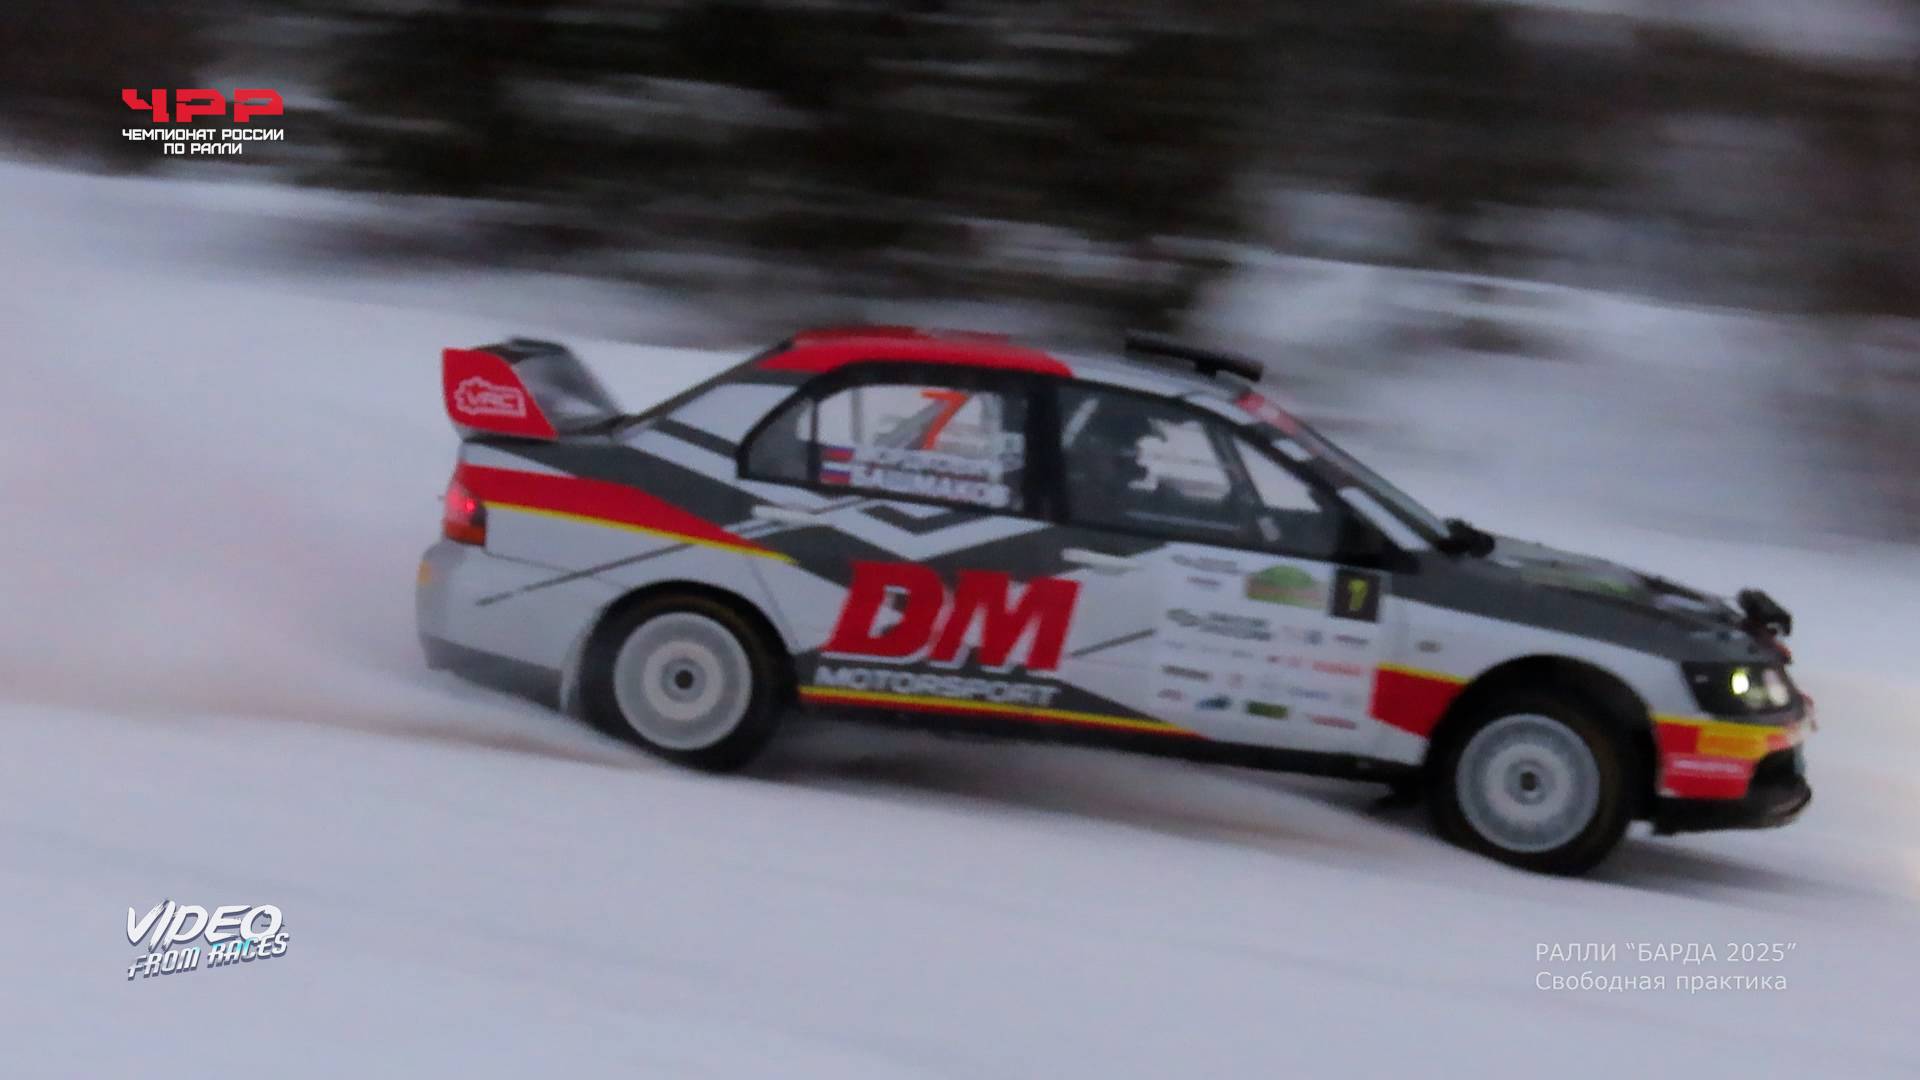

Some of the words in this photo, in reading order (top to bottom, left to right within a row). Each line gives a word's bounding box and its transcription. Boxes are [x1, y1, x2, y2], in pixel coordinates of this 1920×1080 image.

[917, 390, 969, 451] 7
[820, 560, 1082, 672] DM
[814, 664, 1060, 707] MOTORSPORT
